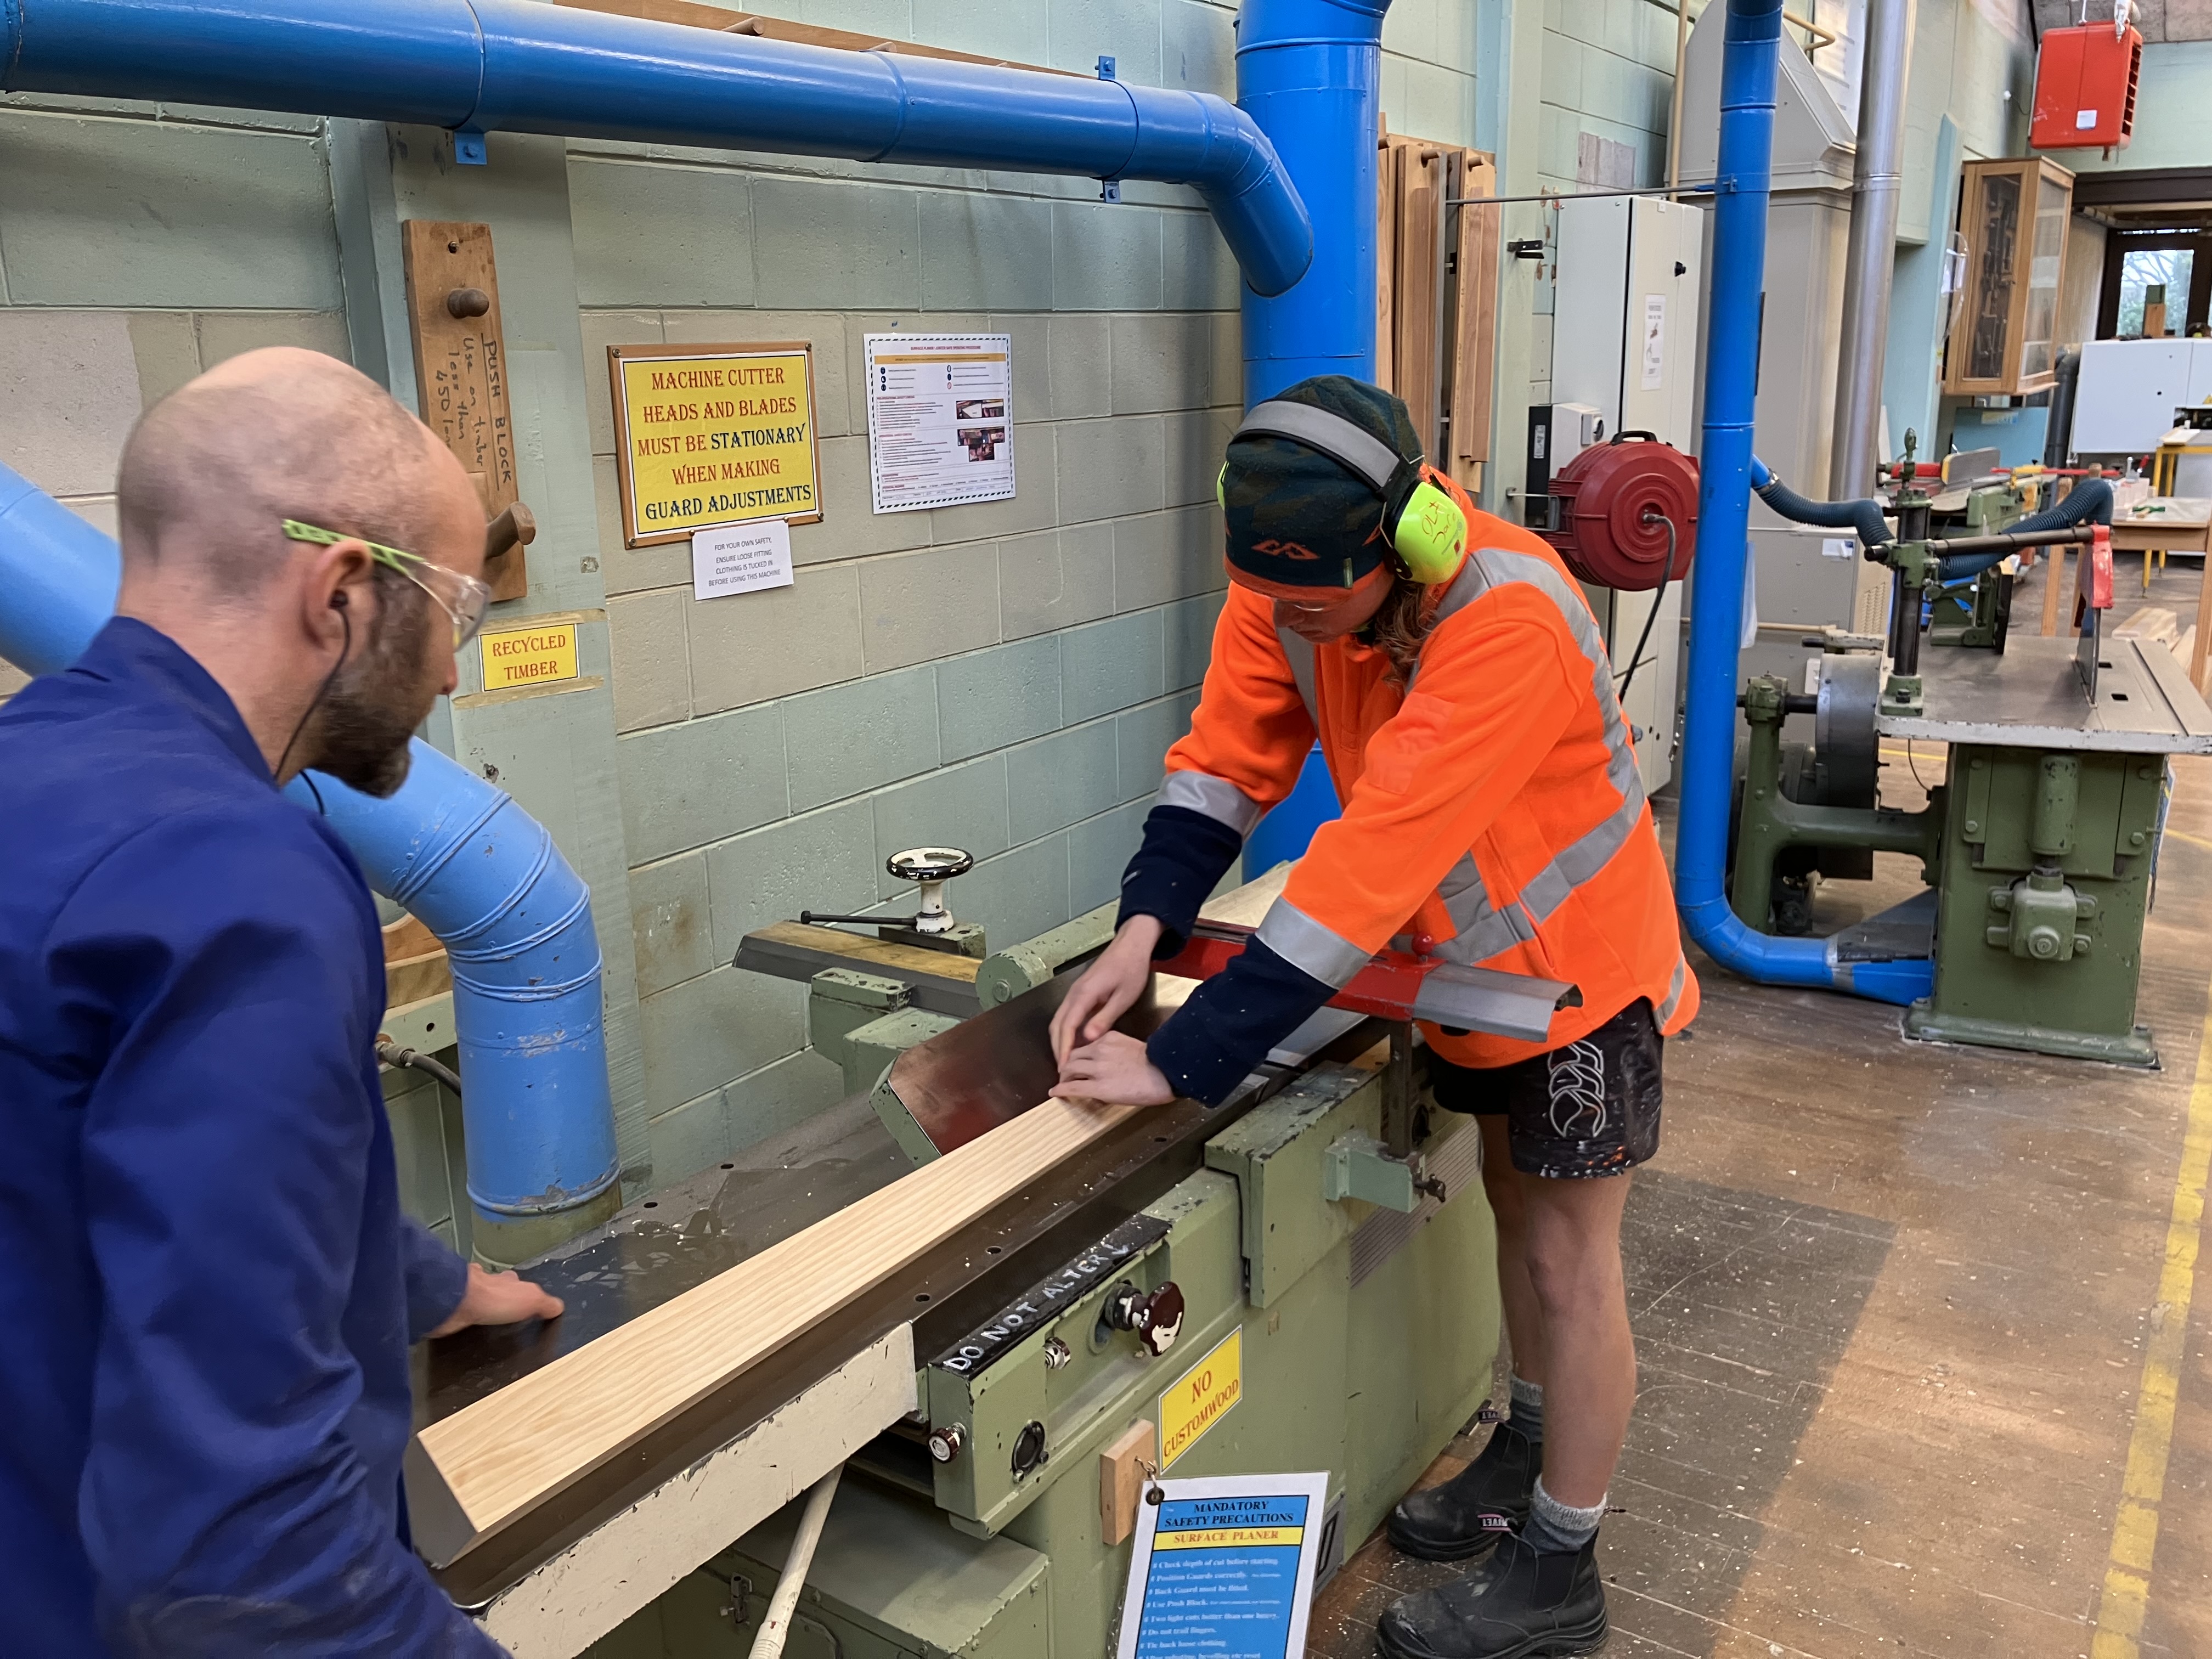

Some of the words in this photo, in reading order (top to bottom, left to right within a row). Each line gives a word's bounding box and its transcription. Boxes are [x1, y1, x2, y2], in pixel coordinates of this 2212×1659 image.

[463, 337, 474, 374] Use
[470, 386, 476, 407] on
[652, 370, 724, 390] MACHINE
[728, 367, 785, 386] CUTTER
[436, 370, 450, 411] 450
[448, 351, 460, 391] less
[457, 401, 469, 439] than
[484, 341, 500, 397] PUSH
[495, 417, 511, 484] BLOCK
[643, 403, 698, 423] HEADS
[703, 401, 734, 419] AND
[739, 397, 797, 417] BLADES
[637, 436, 680, 456] MUST
[685, 435, 707, 452] BE
[711, 422, 806, 450] STATIONARY
[672, 464, 716, 485] WHEN
[721, 458, 781, 480] MAKING
[646, 498, 702, 520] GUARD
[707, 484, 811, 512] ADJUSTMENTS
[716, 555, 736, 563] ENSURE
[737, 552, 753, 561] LOOSE
[754, 549, 772, 557] FITTING
[716, 565, 741, 574] CLOTHING
[748, 561, 767, 569] TUCKED
[708, 578, 729, 586] BEFORE
[730, 575, 746, 583] USING
[759, 569, 781, 578] MACHINE
[492, 635, 566, 657] RECYCLED
[504, 661, 558, 680] TIMBER
[943, 1346, 984, 1370] DO
[980, 1302, 1038, 1341] NOT
[1042, 1254, 1109, 1299] ALTER
[1192, 1370, 1212, 1404] NO
[1164, 1379, 1239, 1457] CUSTOMWOOD
[1165, 1516, 1209, 1527] SAFETY
[1212, 1513, 1294, 1524] PRECAUTIONS
[1194, 1501, 1269, 1513] MANDATORY
[1173, 1531, 1227, 1543] SURFACE
[1233, 1531, 1278, 1540] PLANER
